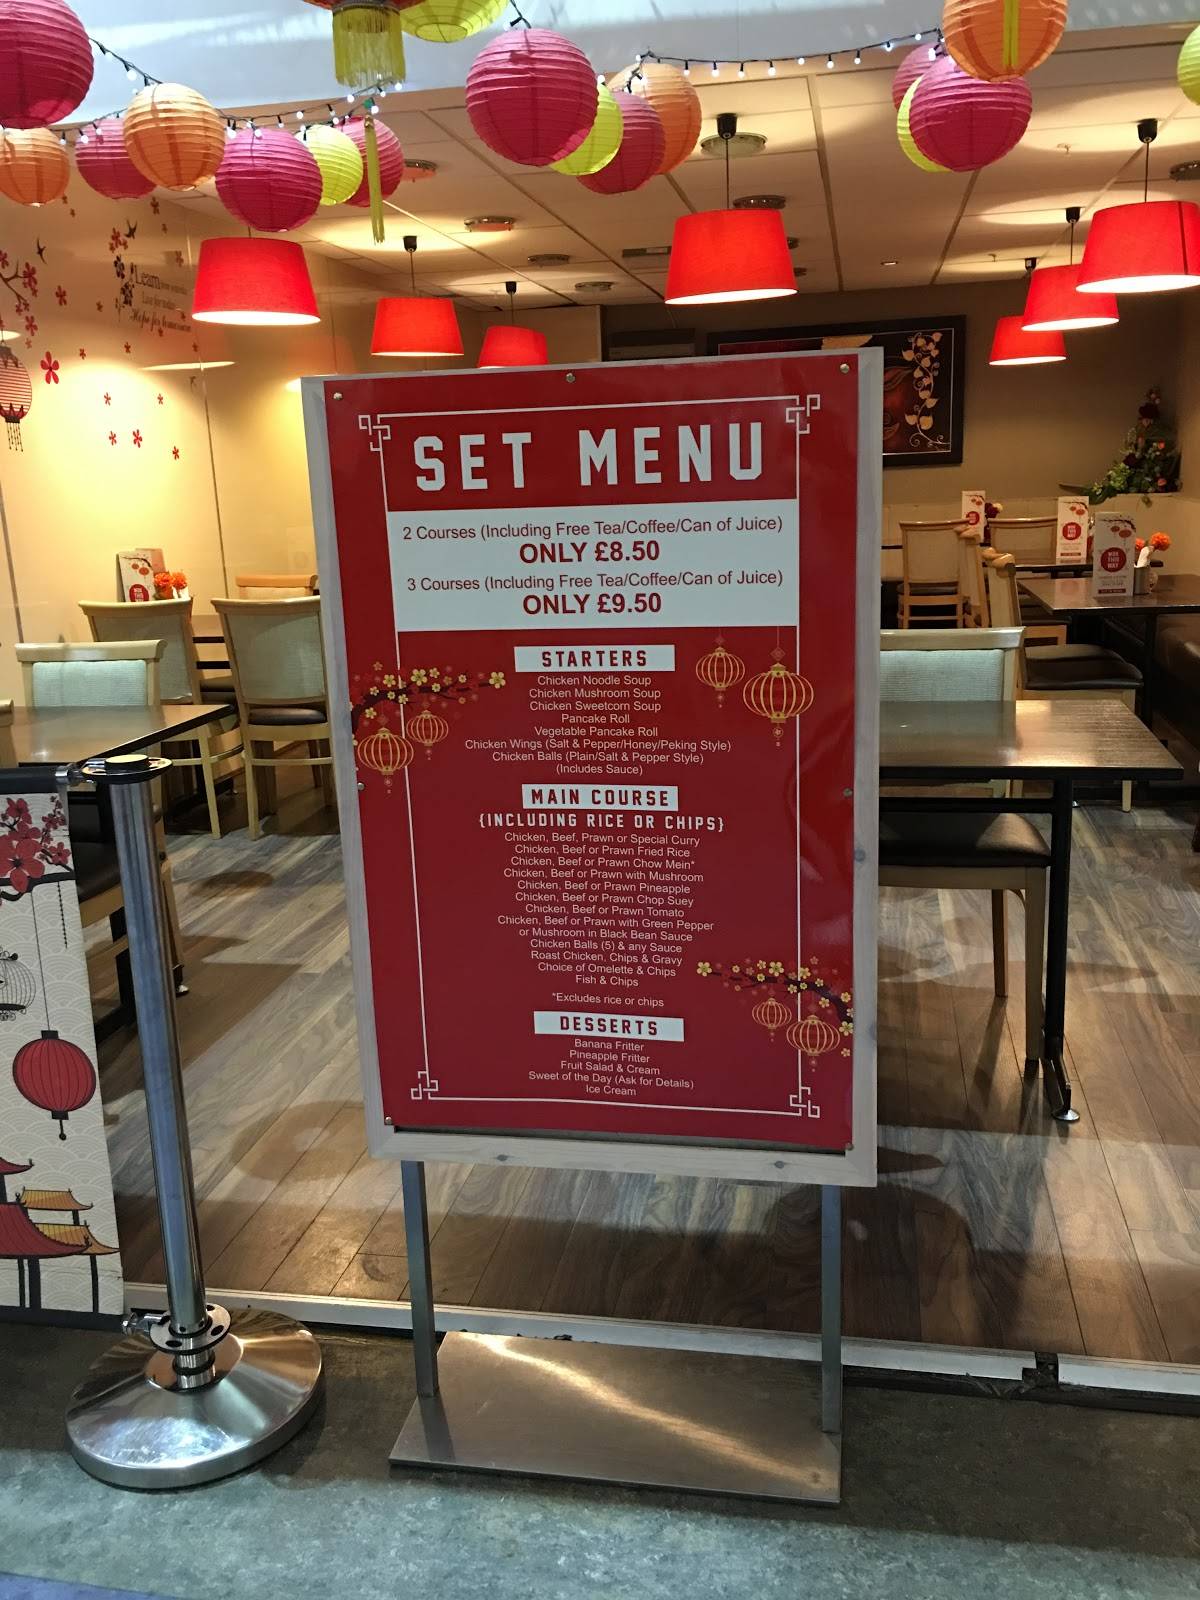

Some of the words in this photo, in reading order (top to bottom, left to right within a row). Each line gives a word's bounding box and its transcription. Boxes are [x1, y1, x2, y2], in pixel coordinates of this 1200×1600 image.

[413, 432, 531, 491] SET
[578, 422, 762, 486] MENU
[402, 526, 412, 540] 2
[416, 526, 476, 539] Courses
[480, 523, 551, 541] (Including
[556, 522, 590, 536] Free
[593, 518, 711, 534] Tea/Coffee/Can
[716, 517, 732, 531] of
[736, 515, 782, 533] Juice)
[519, 542, 587, 563] ONLY
[594, 540, 659, 562] £8.50
[407, 577, 416, 591] 3
[420, 577, 480, 591] Courses
[484, 575, 554, 592] (Including
[559, 574, 592, 588] Free
[596, 571, 712, 587] Tea/Coffee/Can
[717, 570, 733, 584] of
[736, 569, 783, 587] Juice)
[523, 593, 590, 615] ONLY
[597, 592, 661, 613] £9.50
[541, 650, 646, 667] STARTERS
[537, 675, 580, 685] Chicken
[583, 675, 620, 685] Noodle
[623, 674, 651, 687] Soup
[529, 688, 571, 698] Chicken
[574, 688, 630, 698] Mushroom
[633, 688, 661, 700] Soup
[529, 701, 572, 710] Chicken
[575, 701, 630, 710] Sweetcorn
[633, 700, 661, 712] Soup
[561, 713, 606, 723] Pancake
[609, 713, 630, 723] Roll
[534, 726, 586, 738] Vegetable
[589, 726, 634, 736] Pancake
[638, 726, 658, 736] Roll
[465, 739, 507, 749] Chicken
[509, 739, 542, 750] Wings
[545, 739, 569, 750] (Salt
[572, 739, 580, 748] &
[583, 739, 696, 752] Pepper/Honey/Peking
[700, 740, 731, 752] Style)
[492, 751, 534, 761] Chicken
[537, 751, 562, 760] Balls
[565, 751, 618, 762] (Plain/Salt
[621, 752, 629, 761] &
[632, 752, 670, 764] Pepper
[673, 752, 704, 765] Style)
[556, 763, 603, 775] (Includes
[606, 764, 642, 776] Sauce)
[531, 788, 579, 804] MAIN
[591, 789, 668, 806] COURSE
[586, 813, 624, 828] RICE
[634, 814, 654, 828] OR
[581, 833, 613, 842] Prawn
[630, 834, 668, 845] Special
[671, 835, 700, 847] Curry
[562, 845, 586, 854] Beef
[602, 846, 634, 855] Prawn
[637, 846, 663, 856] Fried
[666, 847, 690, 857] Rice
[558, 857, 581, 866] Beef
[597, 858, 630, 867] Prawn
[633, 858, 662, 868] Chow
[550, 869, 574, 878] Beef
[590, 870, 622, 879] Prawn
[625, 871, 646, 880] with
[649, 871, 703, 882] Mushroom
[564, 881, 588, 890] Beef
[604, 882, 636, 891] Prawn
[639, 882, 690, 895] Pineapple
[562, 892, 586, 902] Beef
[588, 894, 599, 902] or
[601, 894, 634, 903] Prawn
[636, 894, 664, 906] Chop
[667, 895, 693, 908] Suey
[572, 904, 596, 914] Beef
[611, 906, 644, 915] Prawn
[646, 906, 684, 917] Tomato
[544, 916, 568, 925] Beef
[583, 917, 615, 926] Prawn
[618, 918, 638, 927] with
[641, 918, 673, 928] Green
[676, 919, 714, 932] Pepper
[532, 927, 585, 937] Mushroom
[588, 929, 597, 937] in
[600, 929, 627, 938] Black
[630, 930, 657, 940] Bean
[660, 931, 692, 941] Sauce
[530, 939, 571, 948] Chicken
[573, 940, 598, 949] Balls
[601, 941, 615, 952] (5)
[617, 941, 625, 950] &
[628, 943, 647, 953] any
[649, 942, 682, 953] Sauce
[530, 950, 560, 960] Roast
[609, 952, 638, 964] Chips
[641, 954, 649, 963] &
[651, 954, 682, 967] Gravy
[537, 962, 573, 971] Choice
[575, 963, 585, 972] of
[587, 964, 633, 974] Omelette
[636, 965, 644, 974] &
[646, 966, 676, 978] Chips
[575, 974, 596, 984] Fish
[599, 975, 607, 984] &
[609, 976, 638, 988] Chips
[603, 996, 622, 1004] rice
[637, 996, 664, 1008] chips
[560, 1016, 657, 1036] DESSERTS
[574, 1039, 612, 1049] Banana
[615, 1041, 644, 1051] Fritter
[569, 1049, 618, 1061] Pineapple
[621, 1052, 650, 1063] Fritter
[560, 1060, 582, 1070] Fruit
[585, 1062, 613, 1072] Salad
[616, 1064, 623, 1072] &
[626, 1064, 660, 1075] Cream
[528, 1070, 559, 1080] Sweet
[574, 1073, 589, 1082] the
[592, 1074, 612, 1084] Day
[614, 1075, 636, 1085] (Ask
[639, 1076, 653, 1085] for
[655, 1077, 694, 1089] Details)
[586, 1084, 600, 1093] Ice
[603, 1085, 636, 1095] Cream
